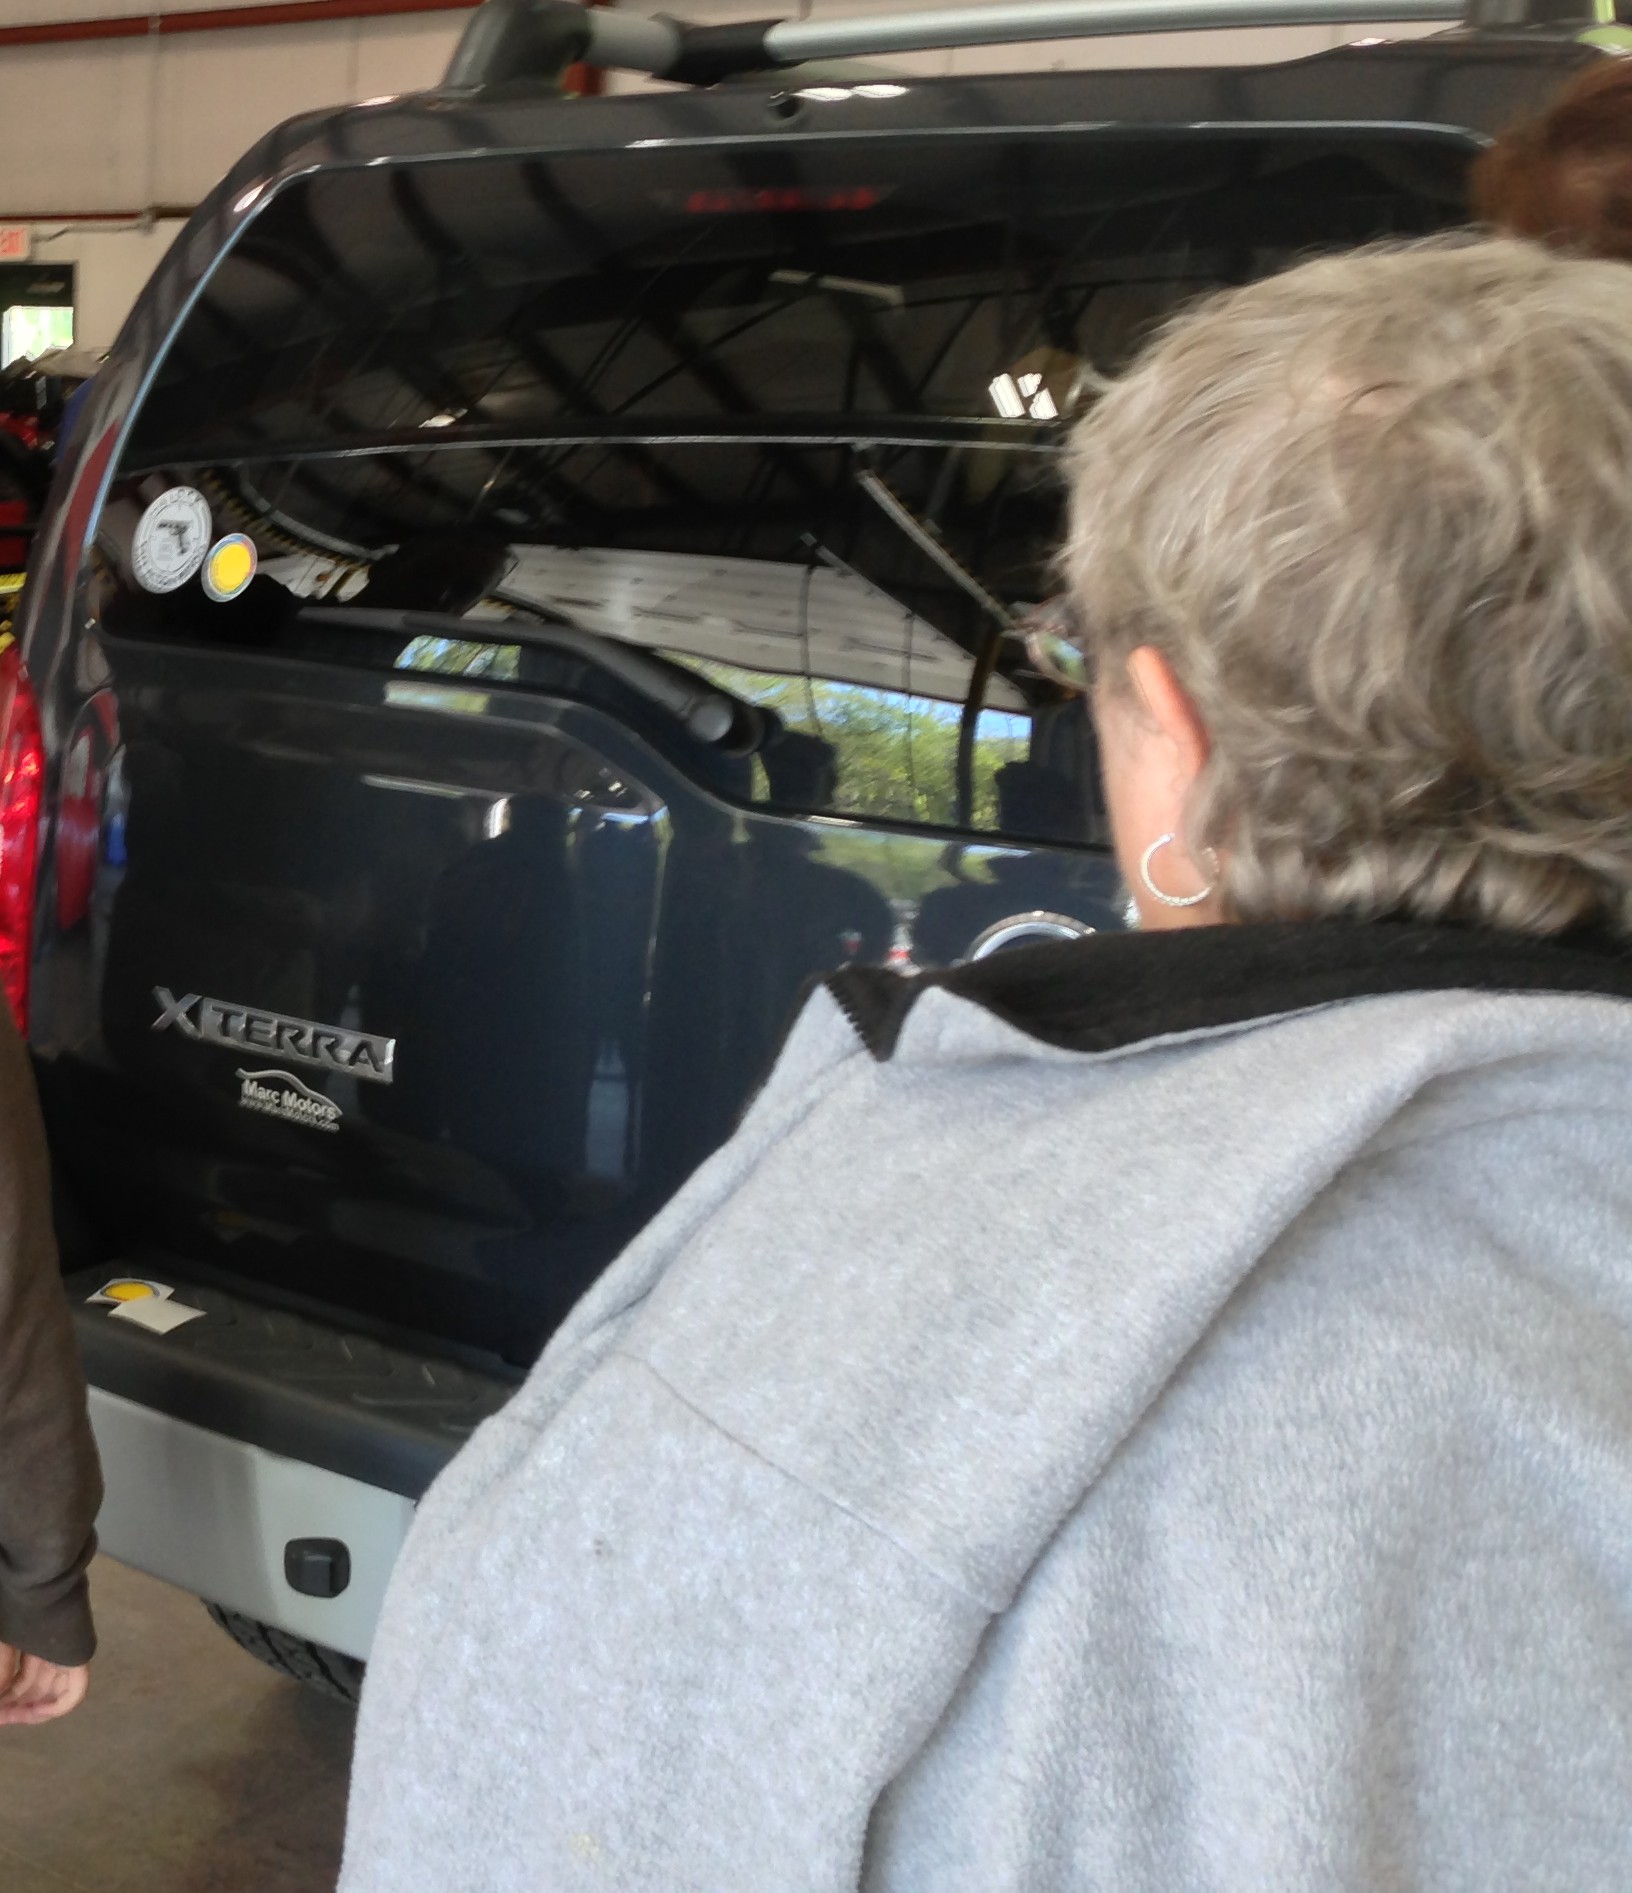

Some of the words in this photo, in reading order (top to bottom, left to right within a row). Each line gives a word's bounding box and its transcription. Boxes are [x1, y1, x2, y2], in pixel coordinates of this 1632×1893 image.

[151, 985, 386, 1074] XTERRA
[242, 1079, 280, 1104] Marc
[280, 1091, 337, 1119] Motors
